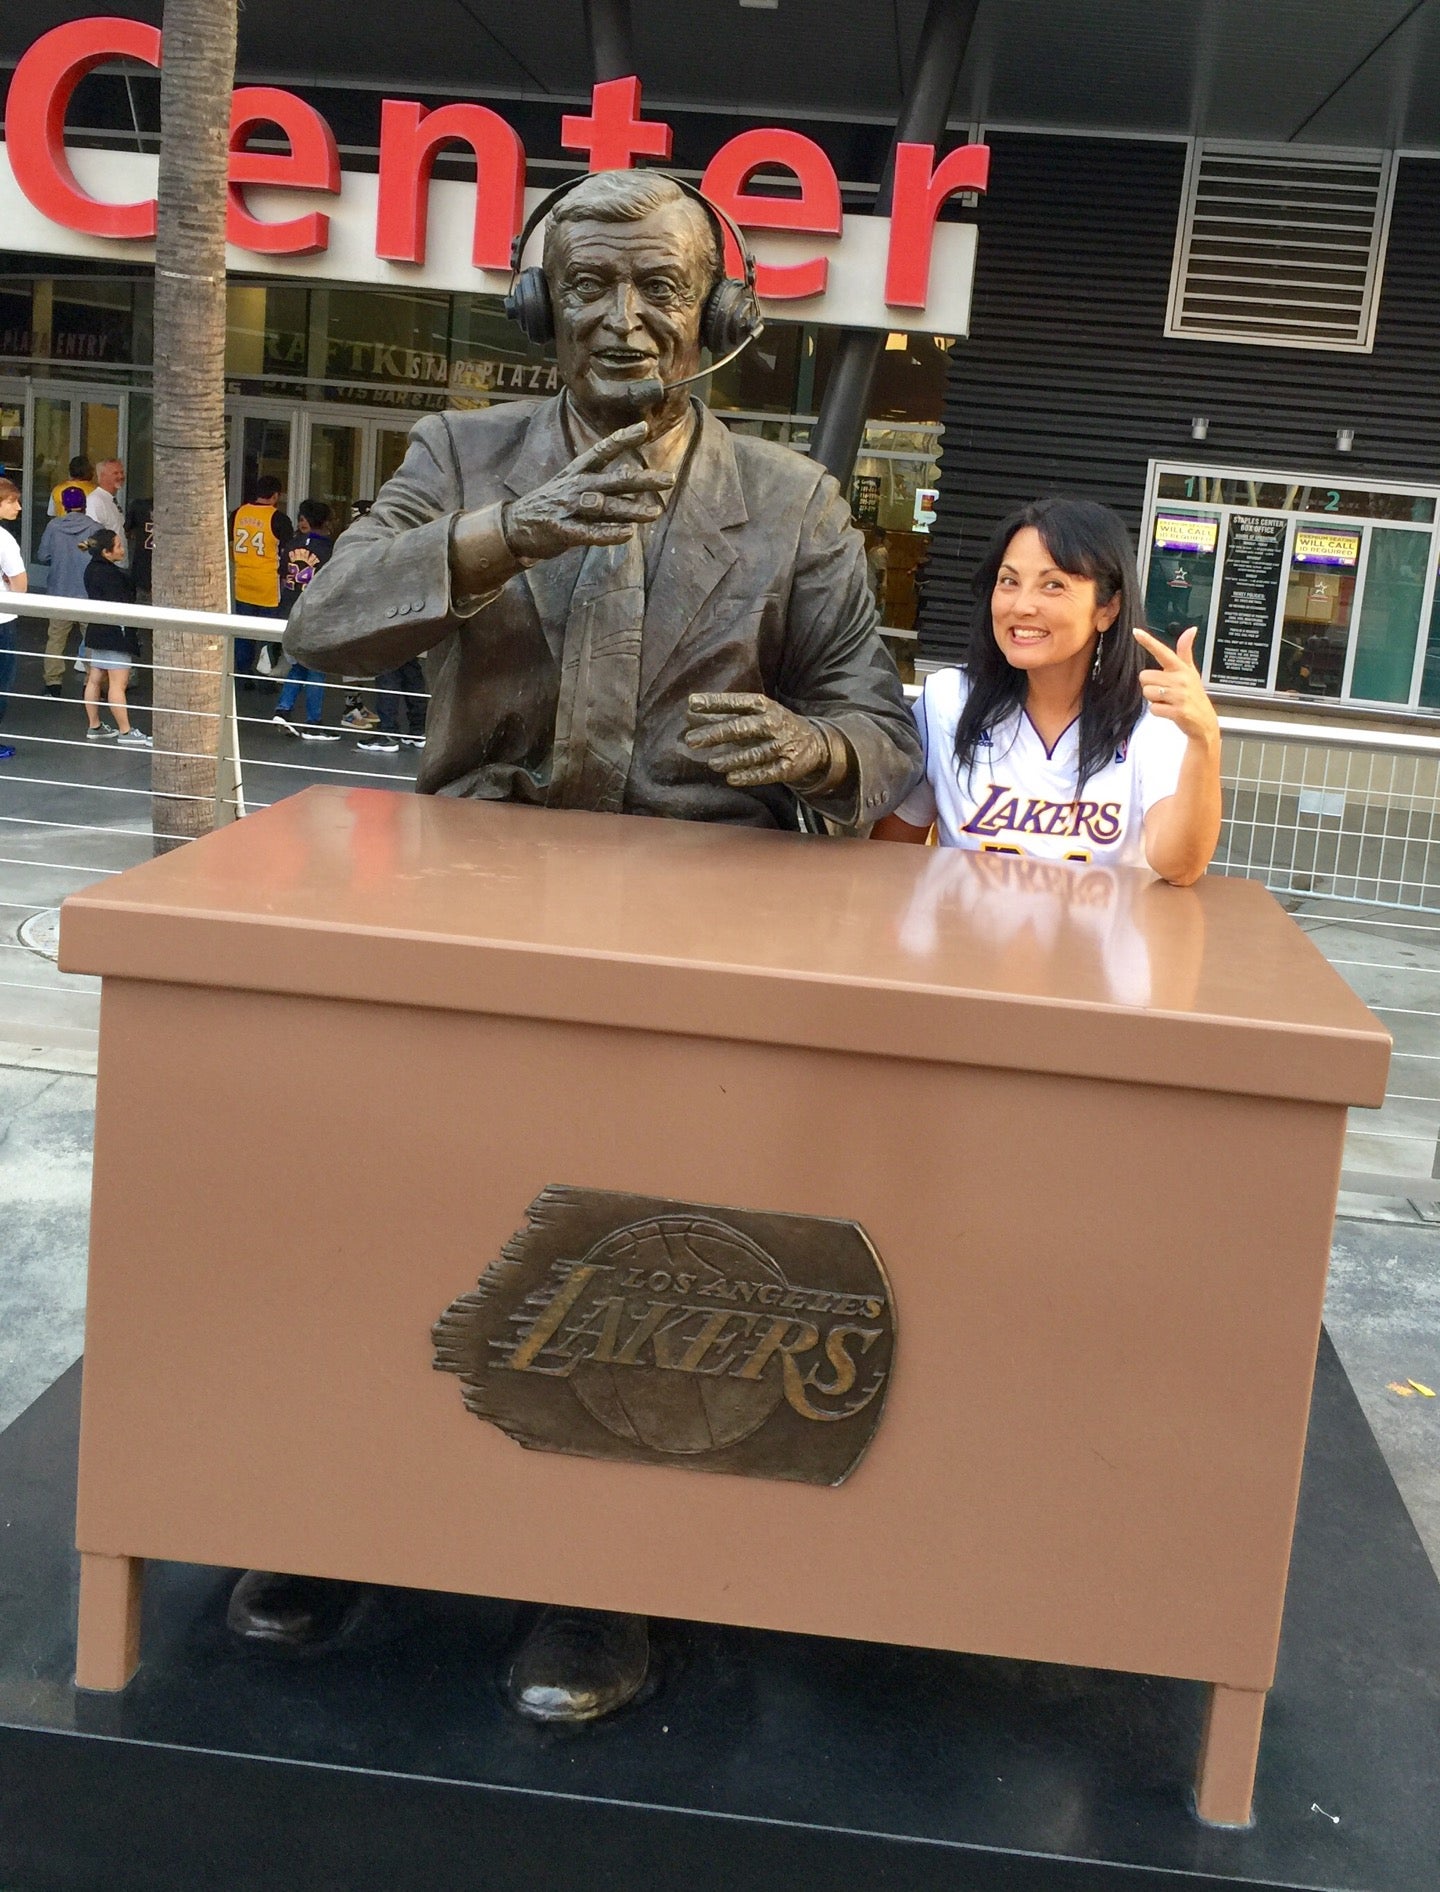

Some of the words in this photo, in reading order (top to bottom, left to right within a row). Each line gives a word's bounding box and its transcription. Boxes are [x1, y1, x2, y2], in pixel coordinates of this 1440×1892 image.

[5, 16, 990, 310] center
[411, 356, 464, 383] STAR
[481, 363, 557, 390] PLAZA
[1184, 476, 1195, 498] 1
[1324, 491, 1341, 511] 2
[1160, 525, 1185, 534] WILL
[1187, 527, 1212, 537] CALL
[1233, 515, 1259, 525] STAPLES
[1260, 518, 1285, 527] CENTER
[1240, 524, 1253, 532] BOX
[1253, 525, 1275, 534] OFFICE
[234, 527, 265, 556] 24
[1300, 538, 1325, 547] WILL
[1327, 541, 1355, 550] CALL
[1310, 547, 1353, 556] REQUIRED
[961, 784, 1122, 845] LAKERS
[620, 1267, 697, 1294] LOS
[697, 1277, 885, 1319] ANGELES
[489, 1259, 885, 1421] LAKERS
